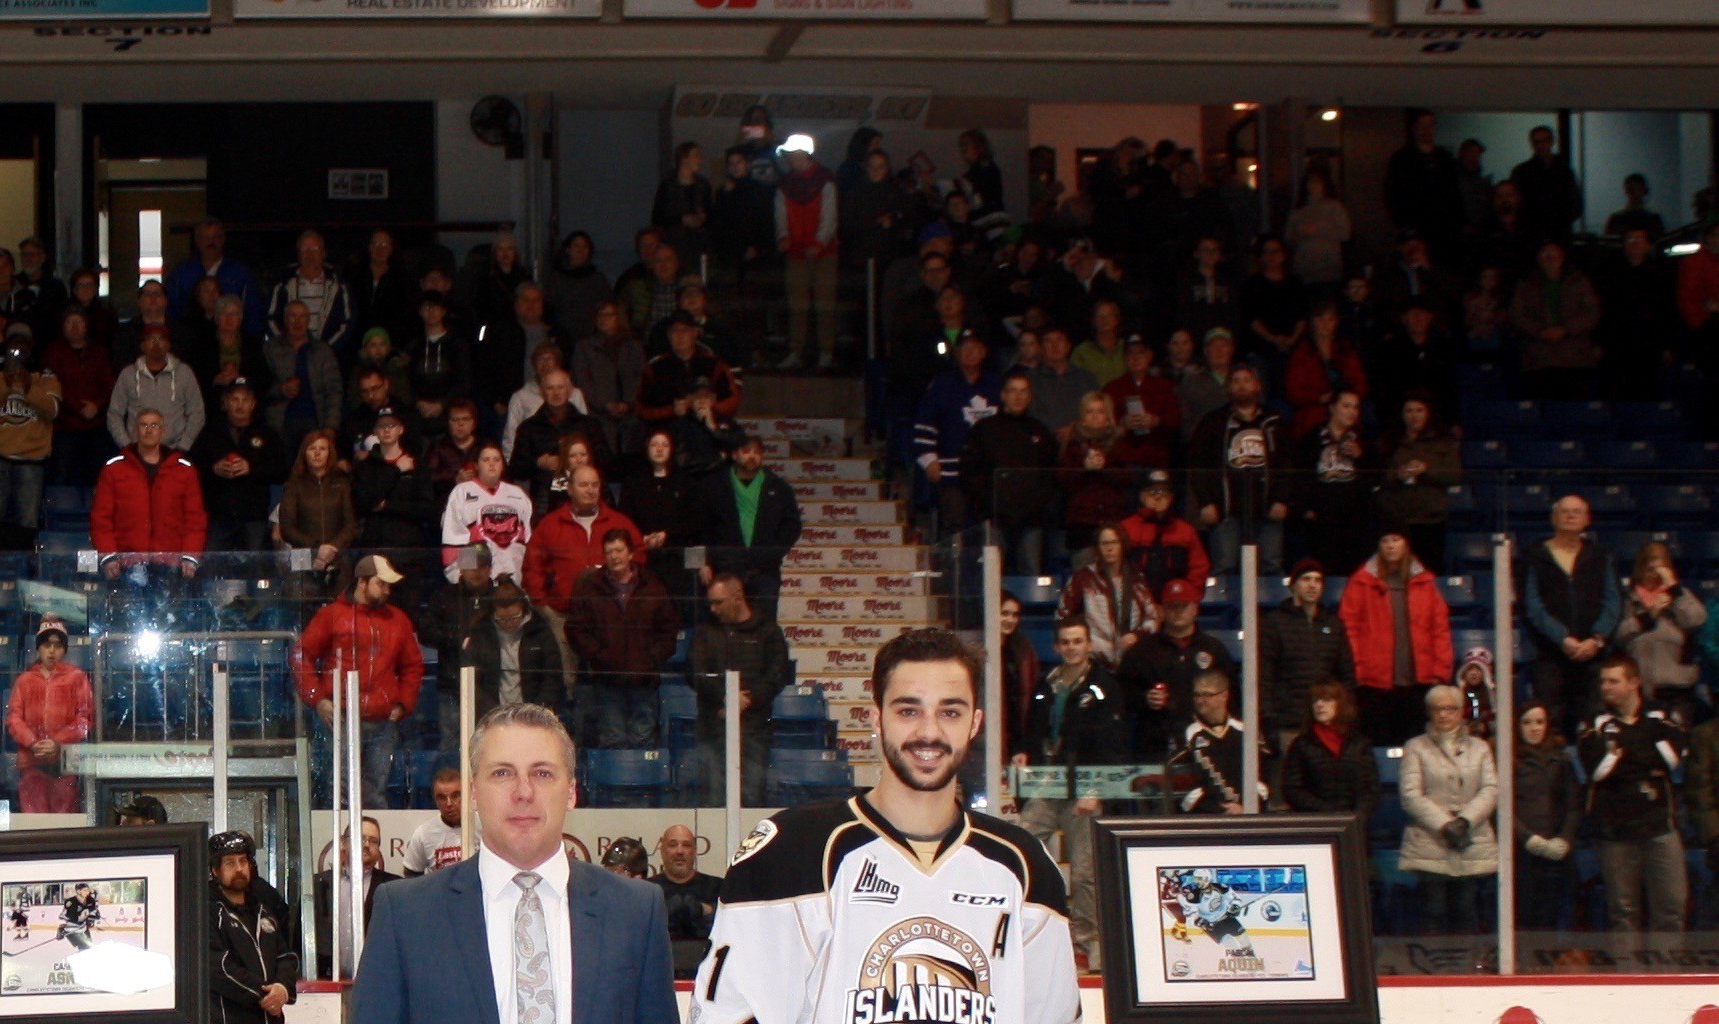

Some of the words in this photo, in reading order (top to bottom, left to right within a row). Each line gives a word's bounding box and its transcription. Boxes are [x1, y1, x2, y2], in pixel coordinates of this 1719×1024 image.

[347, 0, 389, 9] REAL
[393, 0, 452, 9] ESTATE
[33, 26, 212, 36] SECTION
[106, 38, 141, 51] 7
[951, 891, 1008, 906] CCM
[992, 913, 1011, 959] A
[864, 922, 990, 982] CHARLOTTETOWN
[1217, 958, 1265, 972] AQUIN
